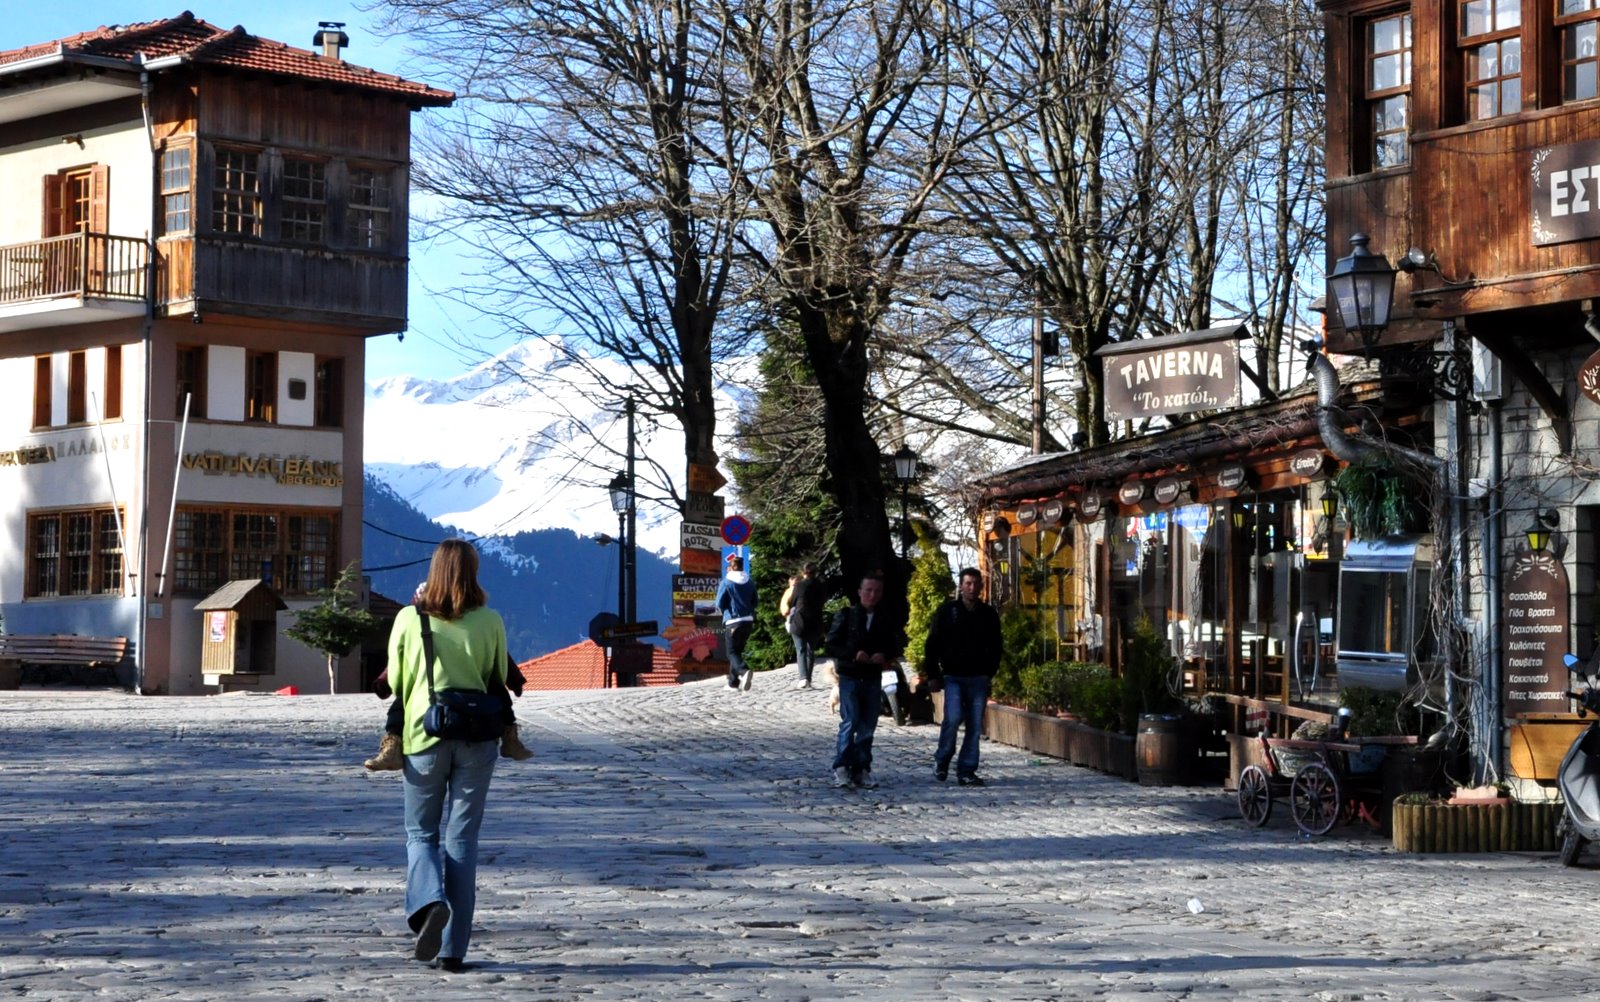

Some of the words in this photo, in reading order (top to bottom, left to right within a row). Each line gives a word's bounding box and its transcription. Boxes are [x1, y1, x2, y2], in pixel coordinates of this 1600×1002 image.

[1120, 351, 1223, 389] TAVERNA
[181, 452, 281, 475] NATIONAL
[285, 458, 344, 476] BANK
[278, 475, 304, 486] NBG
[305, 476, 344, 487] GROUP
[683, 536, 713, 550] HOTEL
[1508, 591, 1547, 601] Φασολάδα
[1527, 606, 1555, 618] Βραστή
[1508, 640, 1546, 651] Χυλόπιτες
[1508, 672, 1549, 683] Κοκκινιστό
